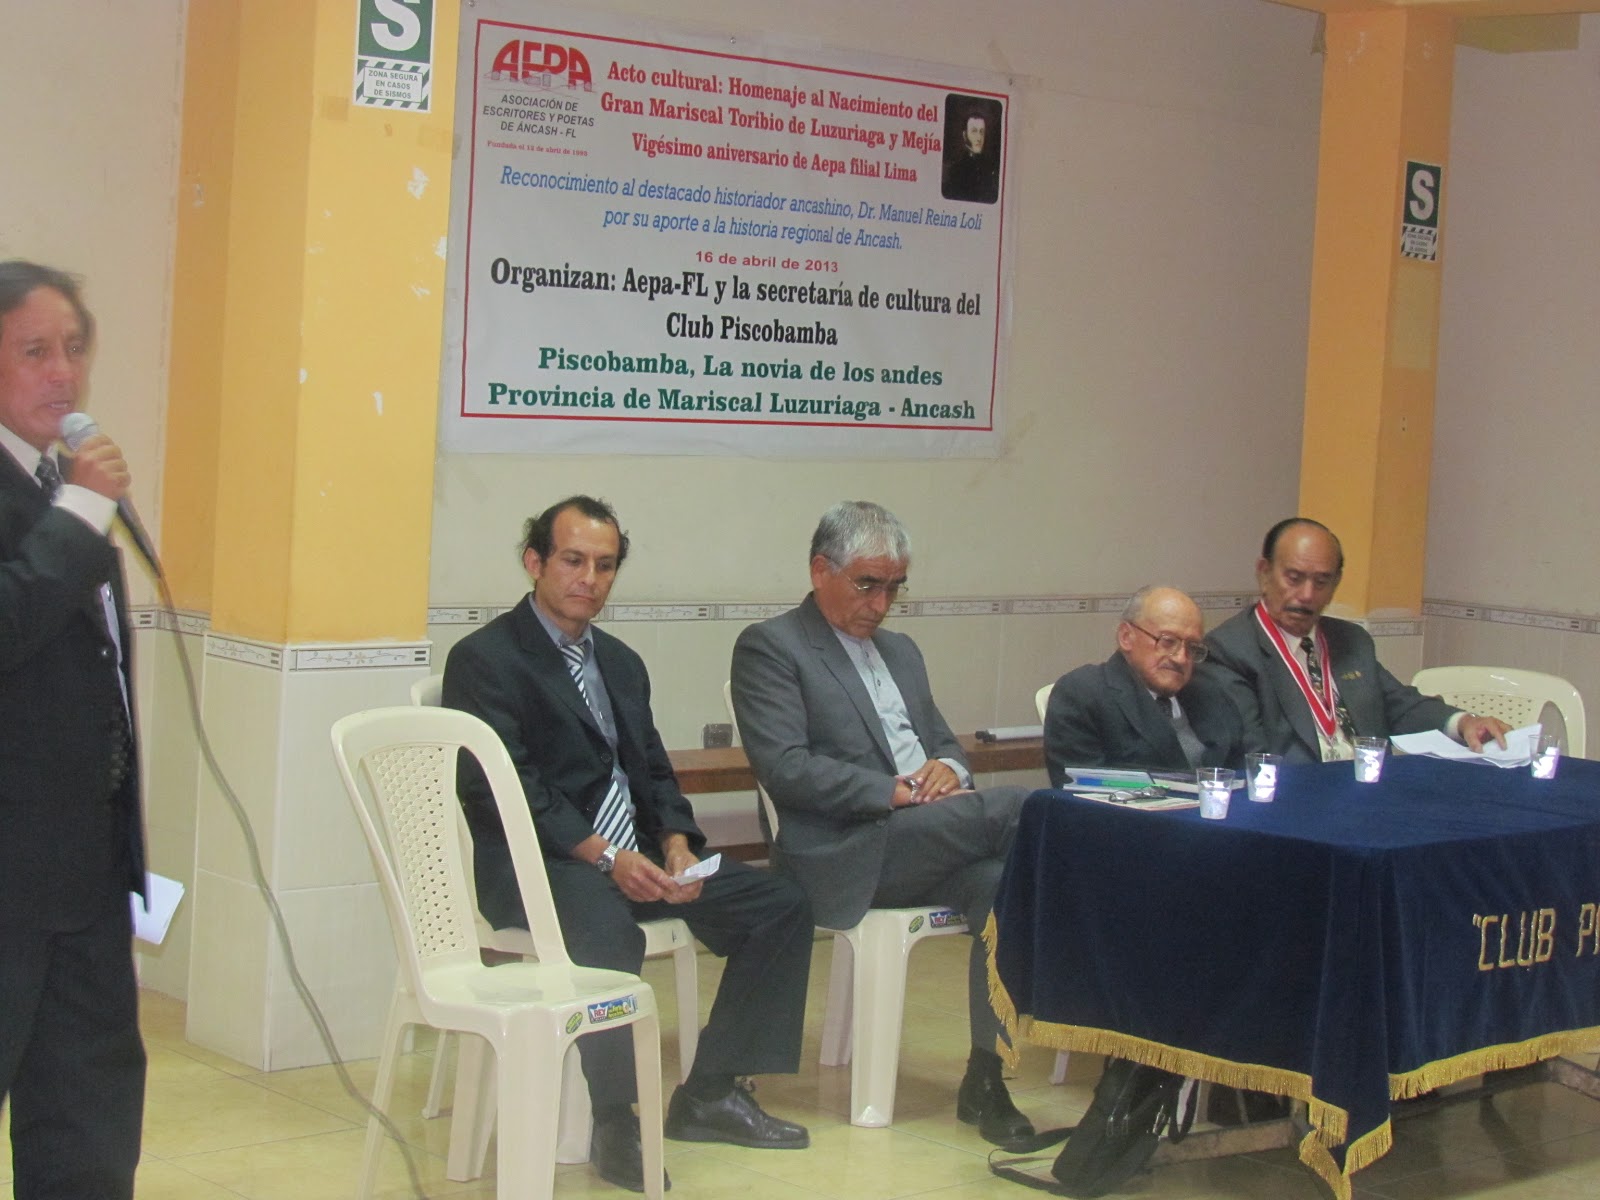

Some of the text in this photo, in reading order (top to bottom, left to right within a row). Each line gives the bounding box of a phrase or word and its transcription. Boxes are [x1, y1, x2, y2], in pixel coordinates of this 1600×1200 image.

[390, 73, 418, 81] SEGURA
[492, 40, 592, 92] AEPA
[385, 91, 411, 99] SISMOS
[501, 94, 578, 112] ASOCIACIÓN DE
[608, 62, 938, 122] Acto cultural: Homenaje al Nacimiento del
[483, 106, 594, 126] ESCRITORES Y POETAS
[500, 121, 514, 131] DE
[516, 121, 558, 136] ÁNCASH
[566, 128, 576, 138] FL
[601, 92, 941, 155] Gran Mariscal Toribio de Luzuriaga y Mejía
[632, 132, 916, 182] Vigésimo aniversario de Aepa filial Lima
[500, 165, 982, 230] Reconocimiento al destacado historiador ancashino, Dr. Manuel Reina Loli
[1410, 170, 1434, 220] S
[603, 210, 902, 249] por su aporte a la historia regional de Ancash.
[696, 251, 838, 272] 16 de abril de 2013
[491, 258, 981, 315] Organizan: Aepa-FL y la secretaría de cultura del
[666, 312, 838, 346] Club Piscobamba
[538, 347, 942, 386] Piscobamba, La novia de los andes
[488, 383, 615, 408] Provincia
[623, 388, 650, 409] de
[658, 389, 762, 412] Mariscal
[770, 393, 881, 421] Luzuriaga
[901, 398, 975, 419] Ancash
